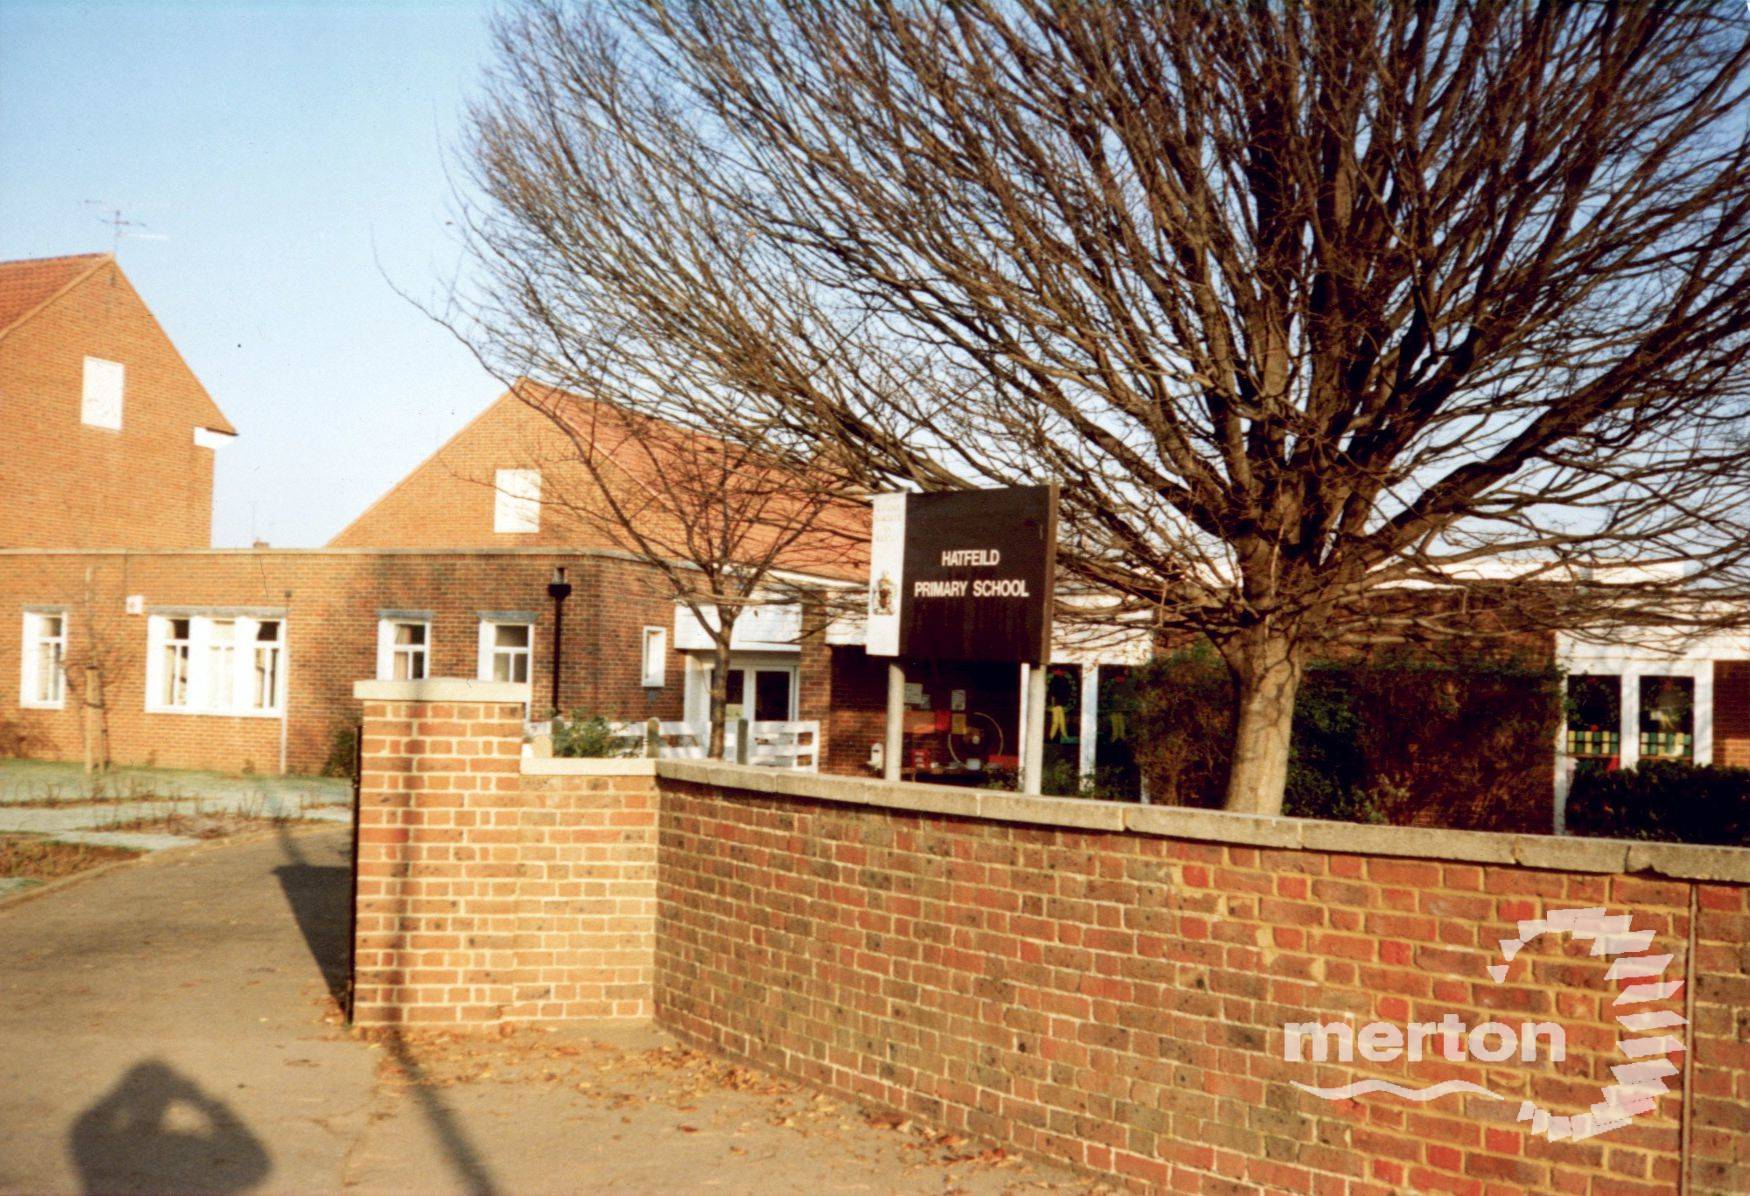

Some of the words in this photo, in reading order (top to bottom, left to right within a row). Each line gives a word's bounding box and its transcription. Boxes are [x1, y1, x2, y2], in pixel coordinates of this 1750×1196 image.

[941, 549, 1000, 567] HATFEILD
[914, 581, 968, 598] PRIMARY
[973, 580, 1029, 598] SCHOOL
